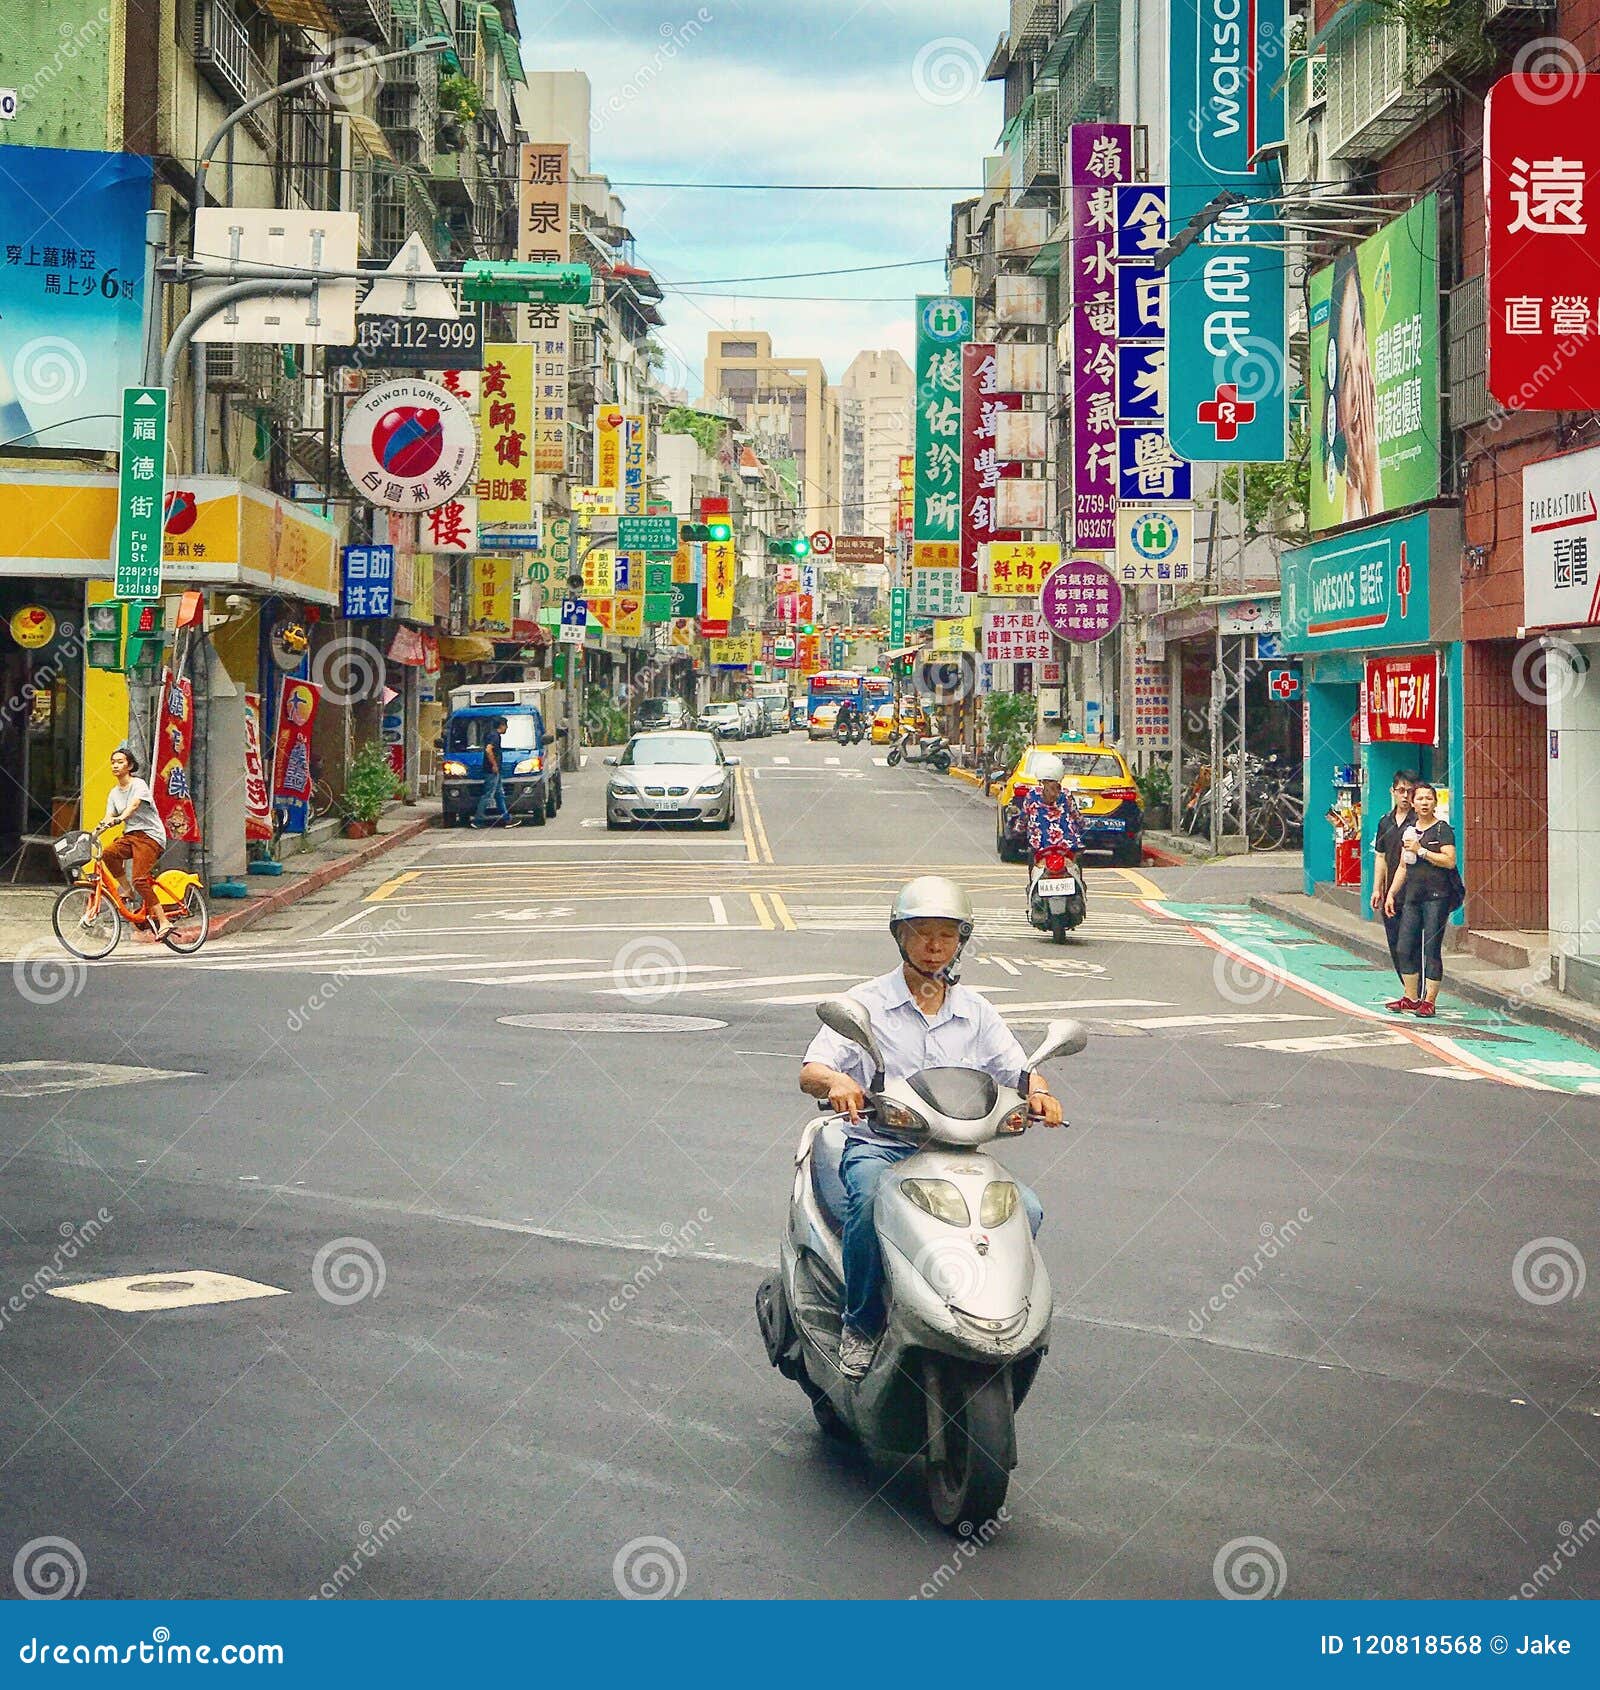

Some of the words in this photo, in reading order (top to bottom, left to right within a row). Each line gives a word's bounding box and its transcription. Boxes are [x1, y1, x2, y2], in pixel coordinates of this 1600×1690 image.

[1507, 156, 1588, 234] 遠
[6, 245, 96, 271] 穿上蘿琳亞
[1504, 296, 1600, 336] 直營
[364, 387, 408, 412] Taiwan
[412, 388, 452, 413] Lottery
[130, 417, 157, 519] 福德街
[475, 478, 528, 502] 自助餐
[131, 530, 147, 542] Fu
[131, 541, 148, 552] De
[131, 552, 148, 563] St.
[347, 550, 390, 579] 自助
[119, 566, 138, 577] 228
[140, 566, 159, 577] 219
[1122, 563, 1189, 580] 台大醫師
[118, 583, 138, 594] 212
[139, 583, 158, 595] 189
[346, 586, 389, 616] 洗衣
[1312, 570, 1355, 615] watsons
[987, 631, 1049, 644] 貨車下貨中
[987, 646, 1051, 661] 請注意安全
